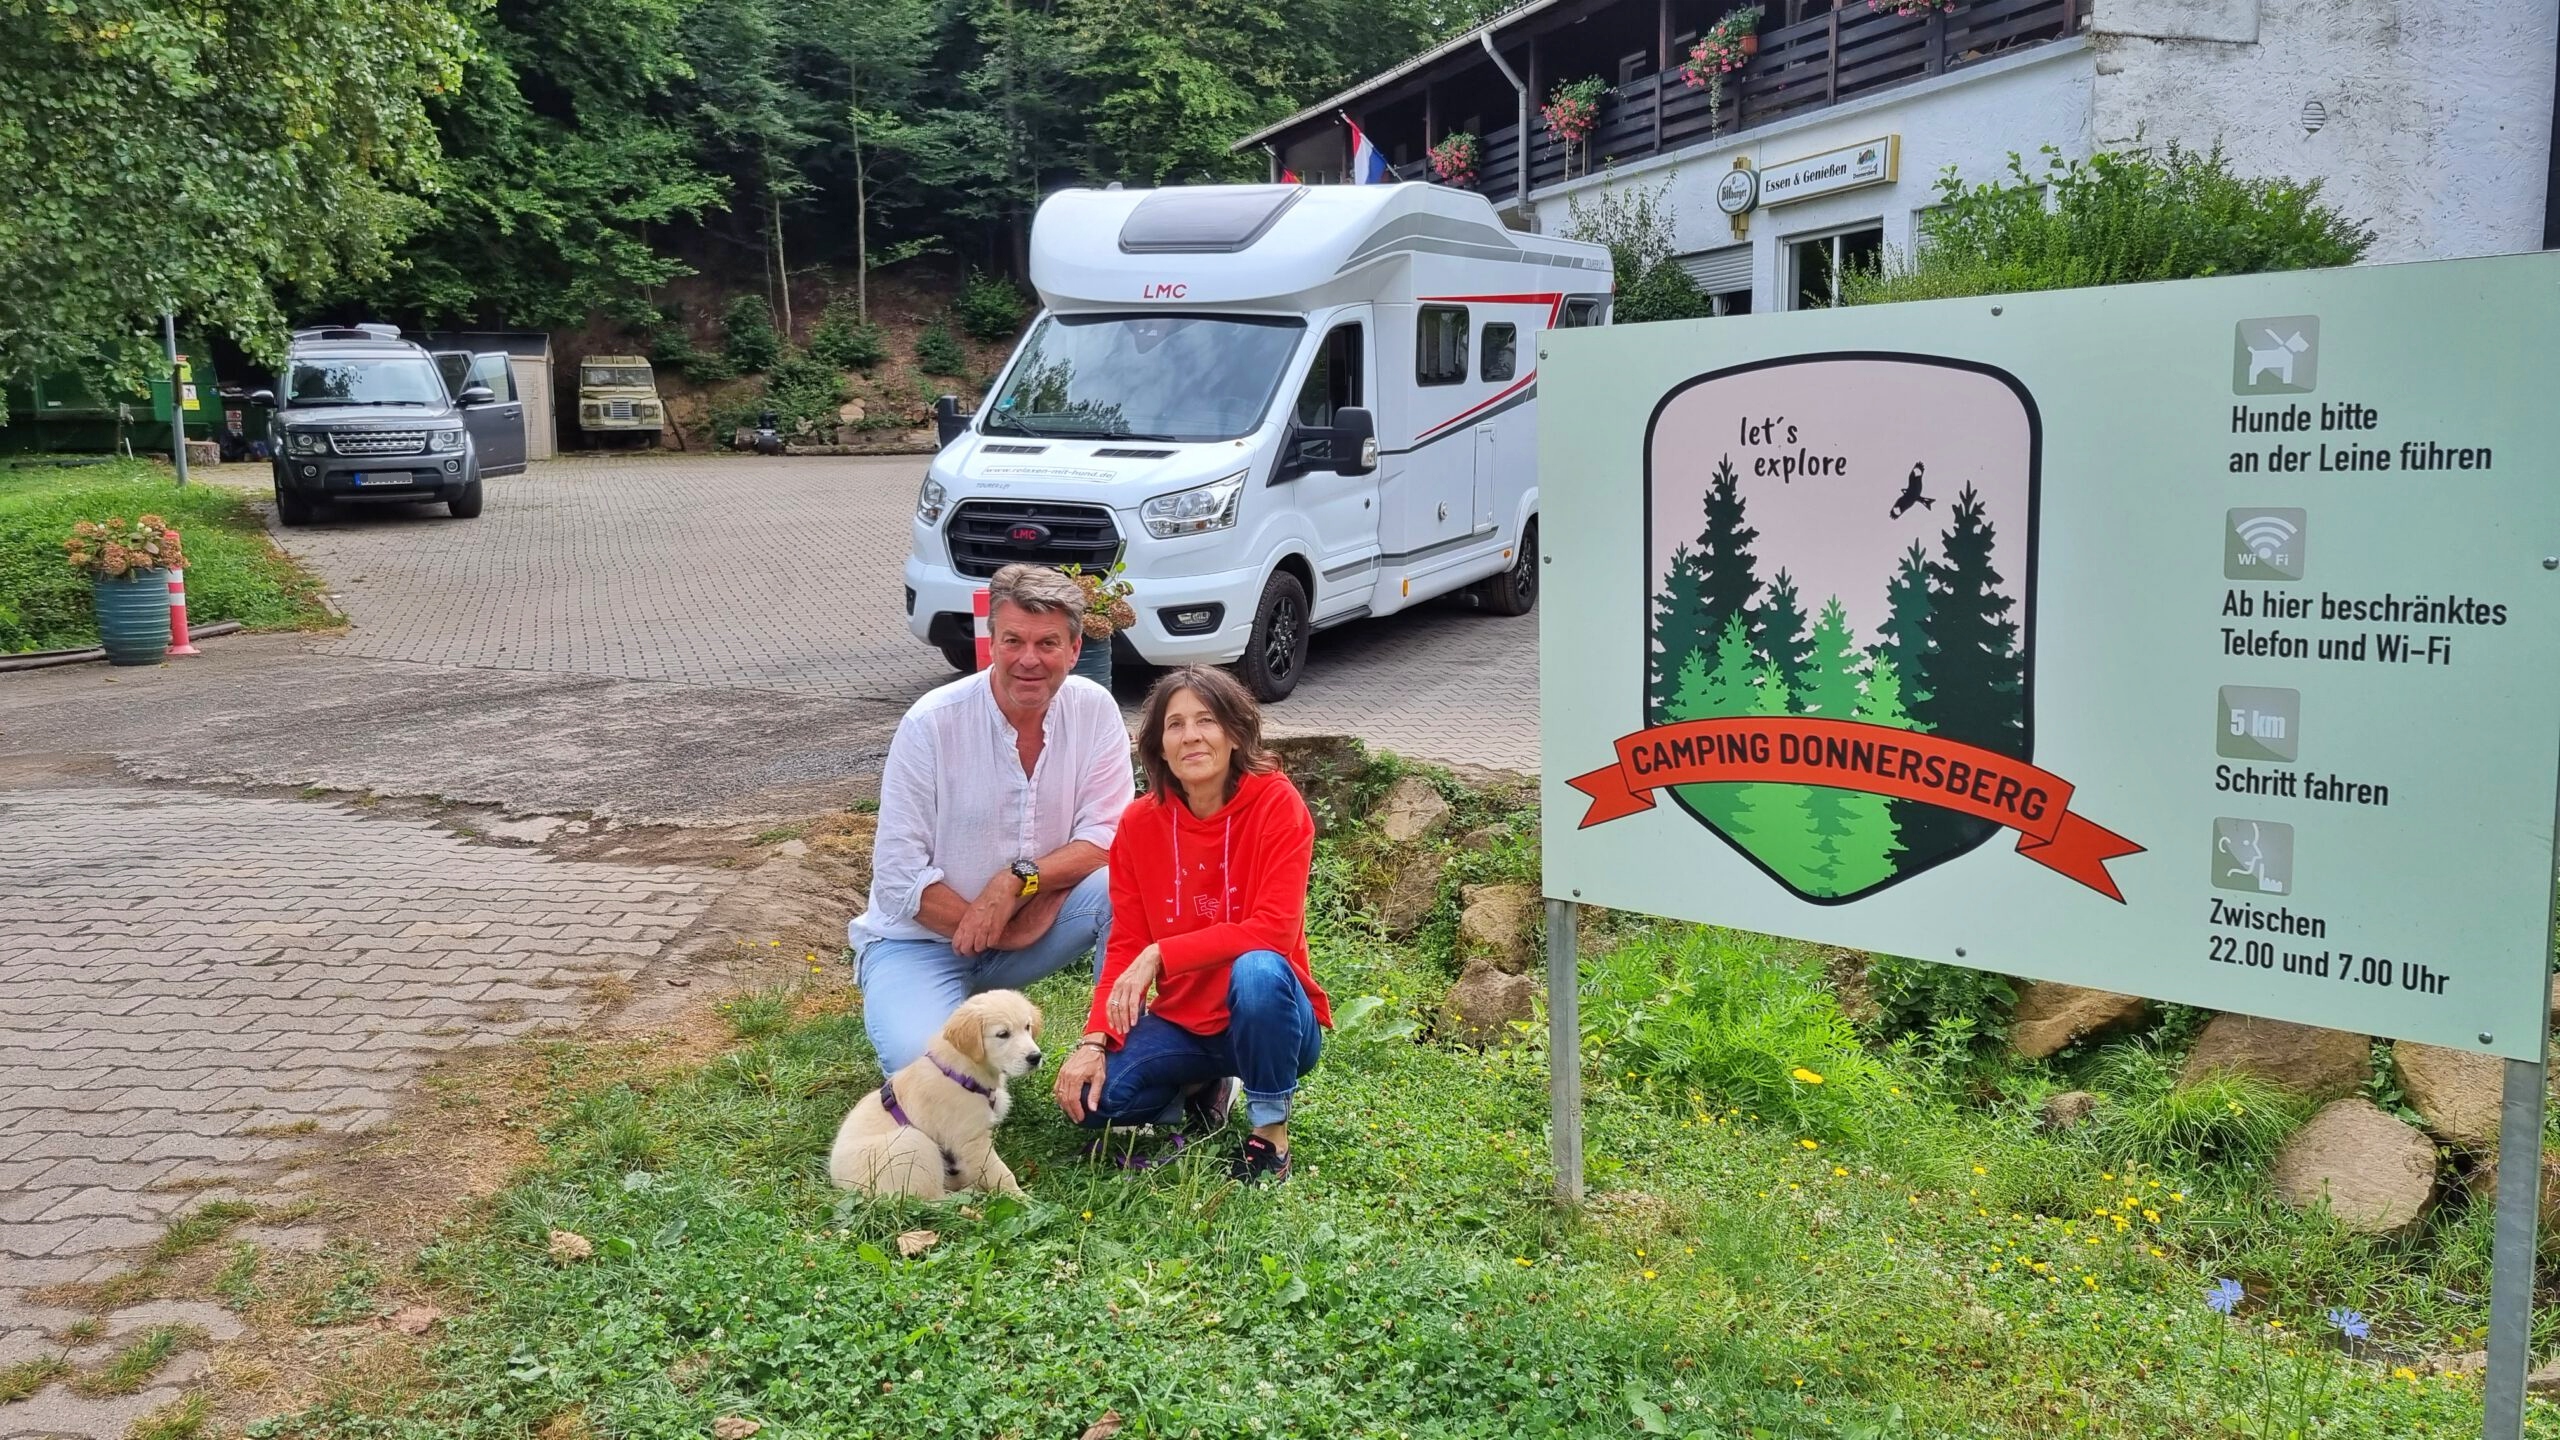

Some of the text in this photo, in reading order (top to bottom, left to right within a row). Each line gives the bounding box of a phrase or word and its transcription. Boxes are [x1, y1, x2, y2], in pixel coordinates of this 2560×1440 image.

[1765, 162, 1847, 193] Essen & Genießen
[1144, 284, 1187, 299] LMC
[2232, 402, 2377, 433] Hunde bitte
[1755, 448, 1846, 483] explore
[2230, 441, 2491, 472] an der Leine führen
[1013, 529, 1037, 540] LMC
[2238, 553, 2289, 566] Wi Fi
[2222, 590, 2507, 625] Ab hier beschränktes
[2221, 628, 2450, 665] Telefon und Wi-Fi
[2230, 709, 2286, 739] 5 km
[1631, 733, 2048, 821] CAMPING DONNERSBERG
[2216, 765, 2388, 806] Schritt fahren
[2210, 898, 2325, 938] Zwischen
[2210, 936, 2449, 994] 22.00 und 7.00 Uhr
